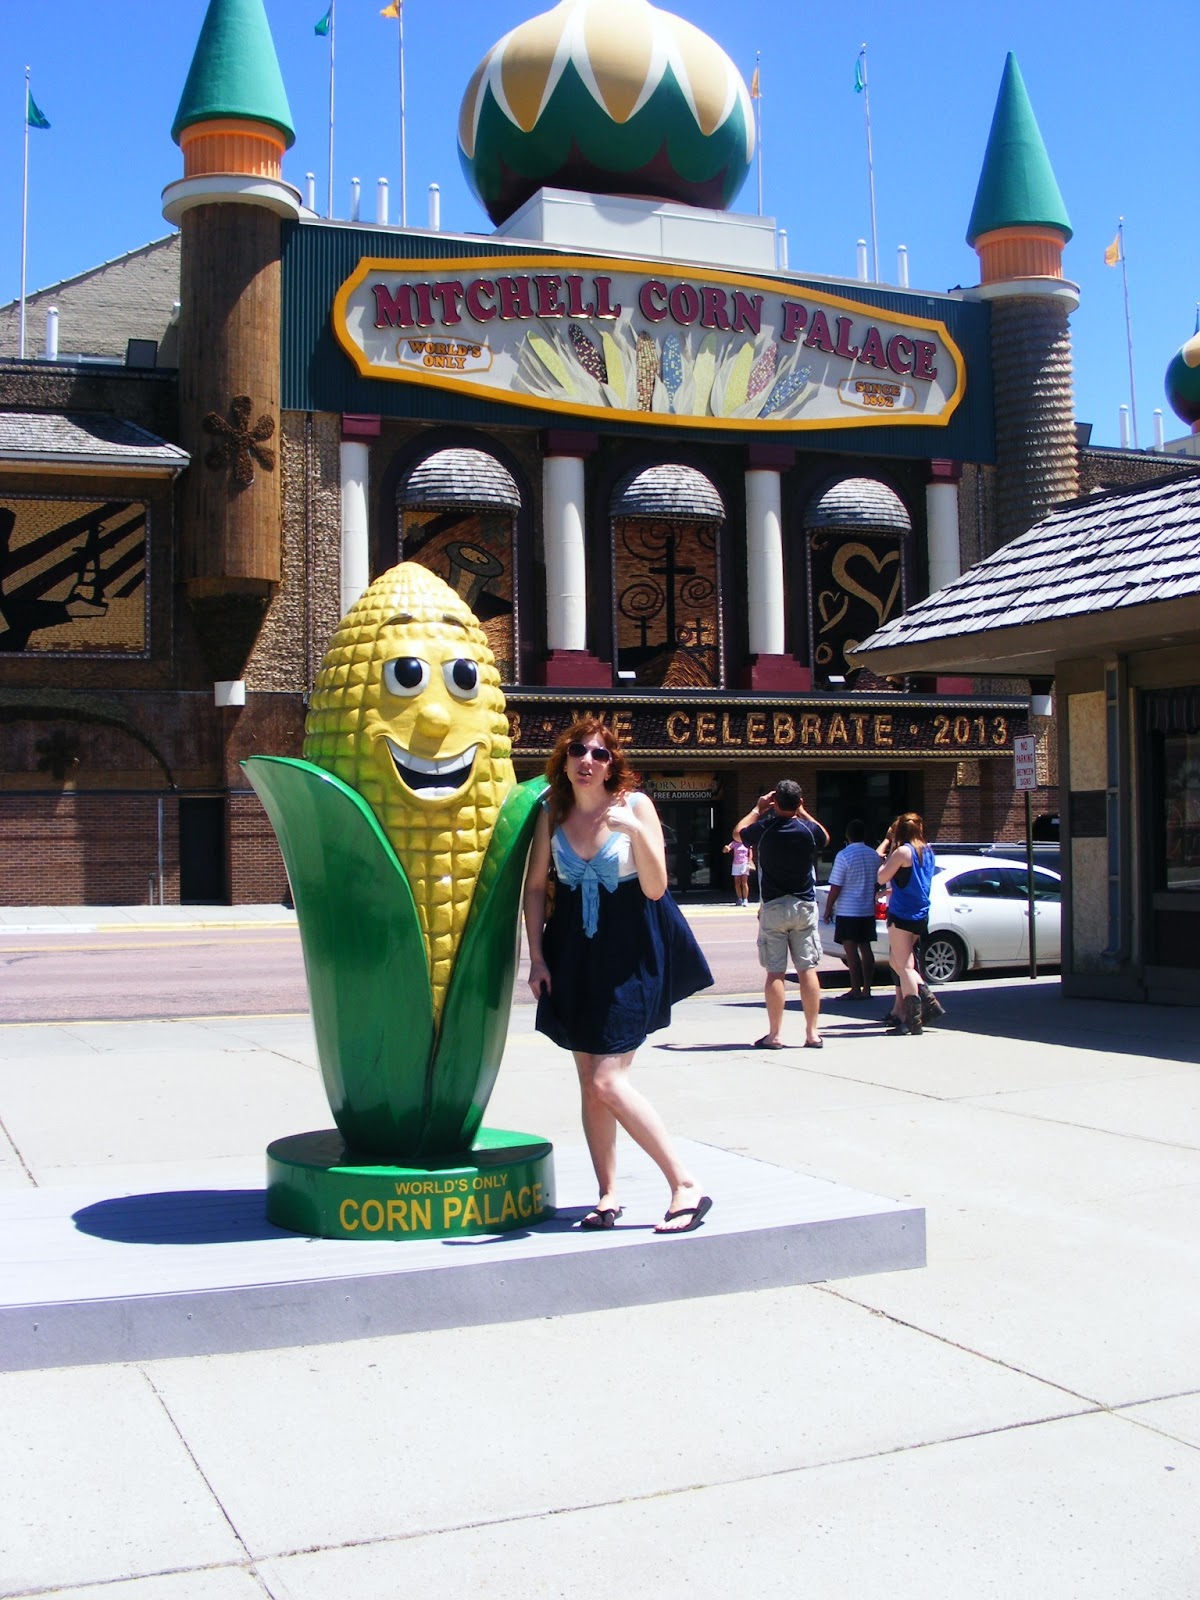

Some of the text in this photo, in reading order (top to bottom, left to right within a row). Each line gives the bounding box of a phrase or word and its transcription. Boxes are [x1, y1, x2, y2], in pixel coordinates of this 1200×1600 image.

[372, 274, 938, 381] MITCHELL CORN PALACE
[408, 340, 482, 357] WORLD'S
[423, 355, 467, 369] ONLY
[854, 381, 901, 397] SINCE
[862, 394, 895, 408] 1892
[666, 711, 893, 745] CELEBRATE
[933, 714, 1008, 745] 2013
[1020, 741, 1028, 751] NO
[1016, 753, 1033, 763] PARKING
[1016, 768, 1034, 777] BETWEEN
[653, 791, 712, 799] FREE ADMISSION
[395, 1173, 508, 1196] WORLD'S ONLY
[339, 1183, 544, 1232] CORN PALACE
